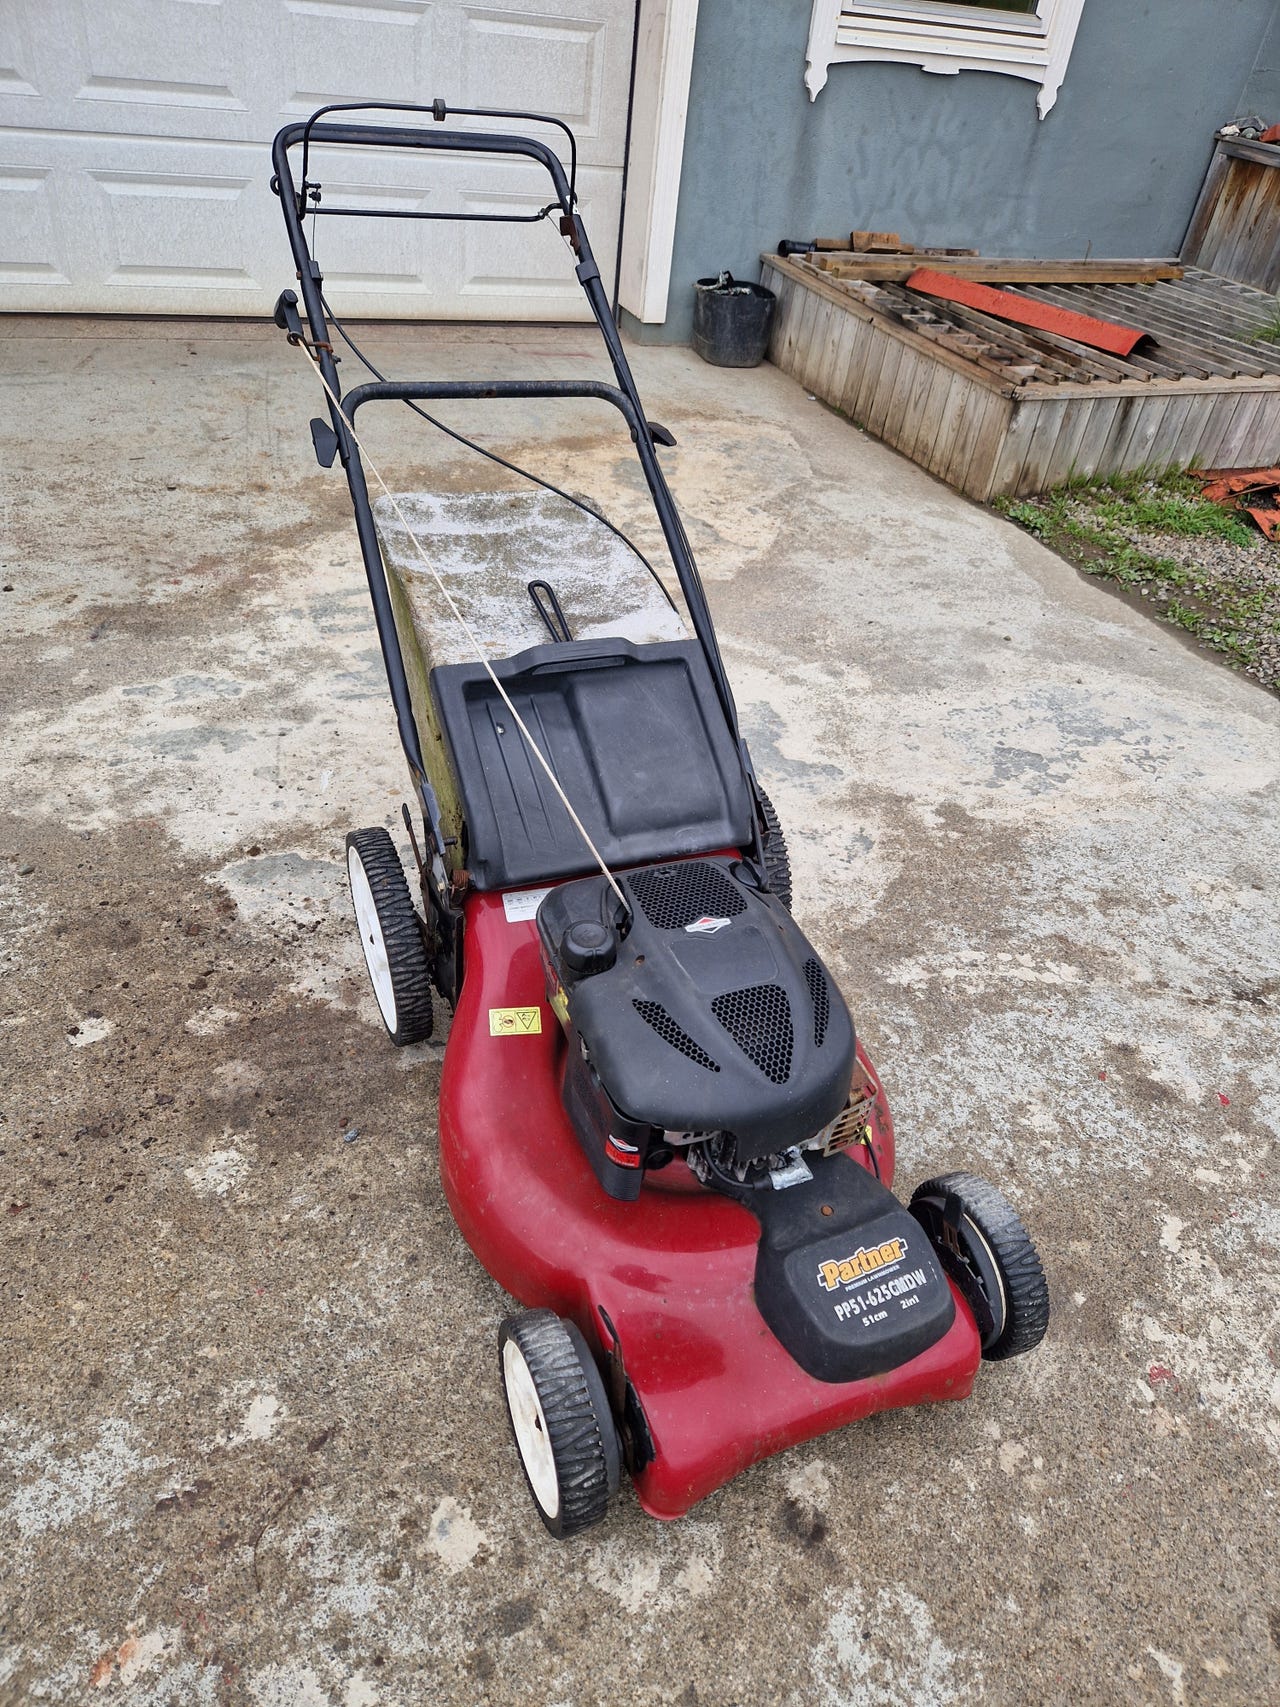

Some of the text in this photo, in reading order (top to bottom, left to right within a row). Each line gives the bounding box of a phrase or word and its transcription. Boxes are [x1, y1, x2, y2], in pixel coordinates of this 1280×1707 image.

[821, 1239, 904, 1289] Partner
[834, 1269, 927, 1322] PP51-625GMDW
[862, 1295, 920, 1327] 51cm 2in1
